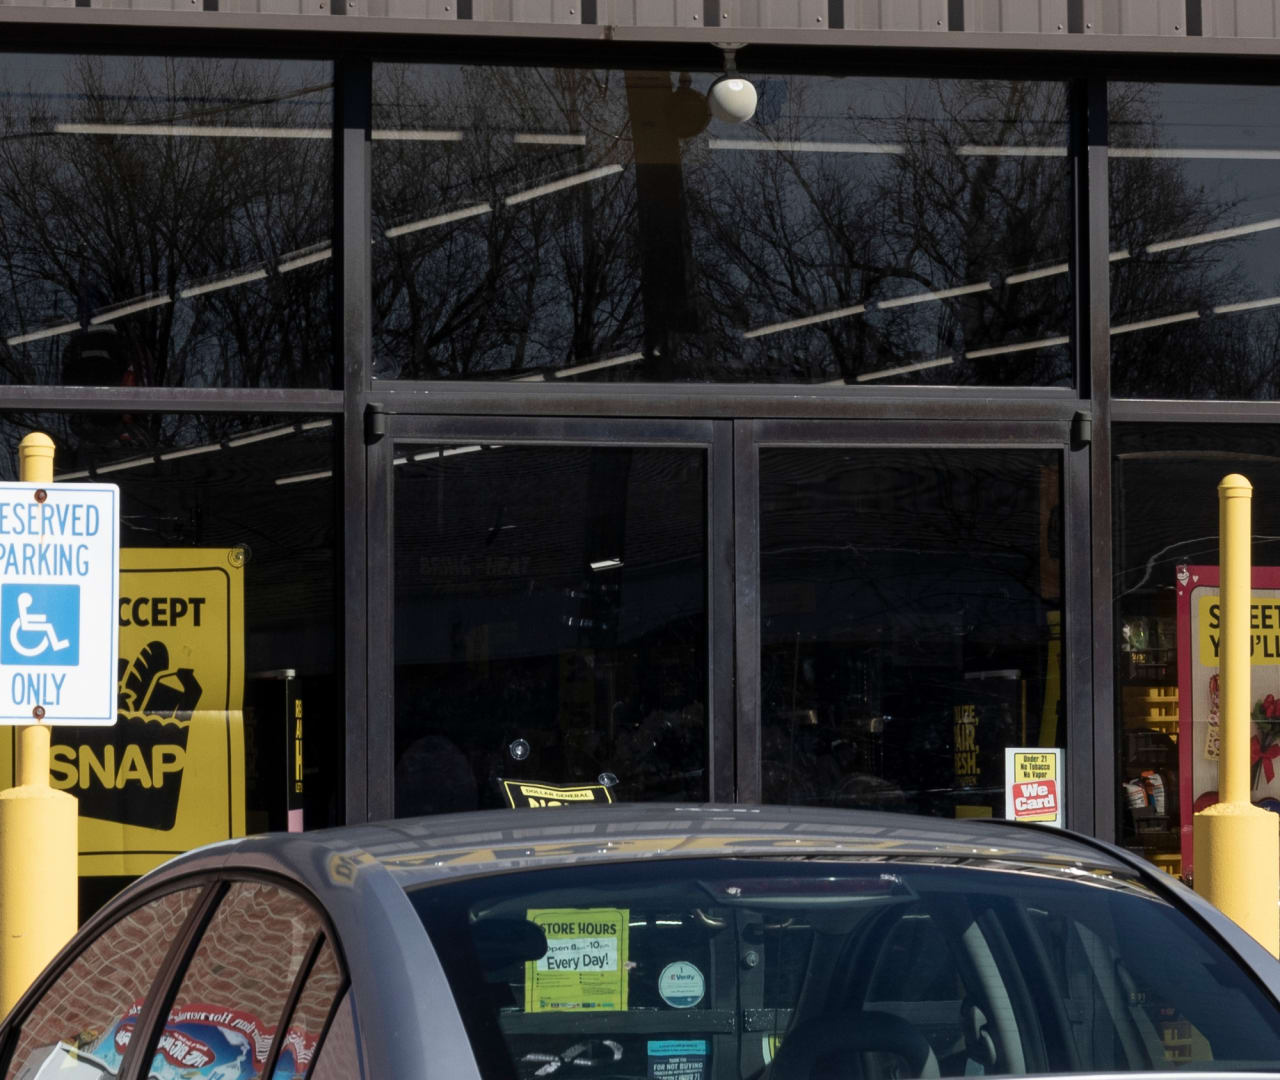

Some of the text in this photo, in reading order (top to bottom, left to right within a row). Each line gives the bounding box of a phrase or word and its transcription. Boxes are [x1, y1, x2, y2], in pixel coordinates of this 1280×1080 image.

[118, 597, 206, 627] CCEPT
[11, 672, 66, 705] ONLY
[1023, 755, 1048, 763] Under 21
[50, 744, 187, 790] SNAP
[1032, 771, 1048, 779] Vapor
[1020, 783, 1049, 797] We
[1015, 794, 1056, 811] Card
[541, 922, 617, 935] STORE HOURS
[548, 944, 569, 953] pen
[547, 953, 609, 970] Every Day!
